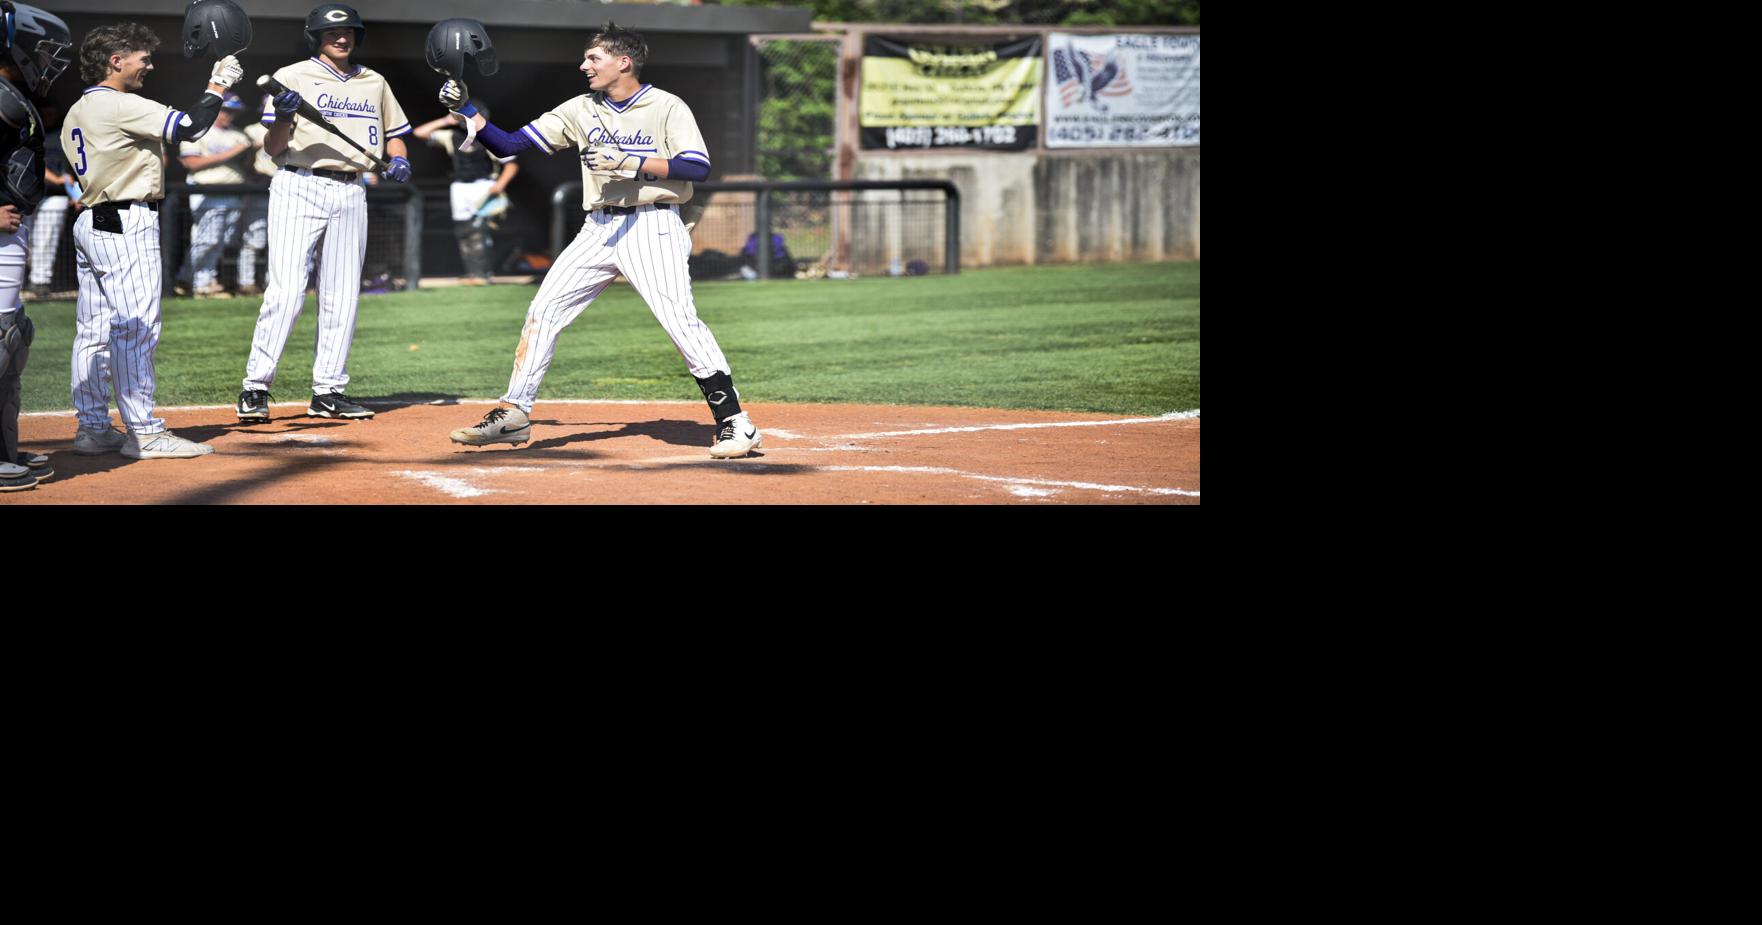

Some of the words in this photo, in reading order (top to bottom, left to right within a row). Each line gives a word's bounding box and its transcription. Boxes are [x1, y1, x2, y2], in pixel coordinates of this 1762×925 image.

[324, 9, 349, 22] C
[317, 93, 377, 113] Chickasha
[368, 125, 379, 146] 8
[71, 127, 87, 177] 3
